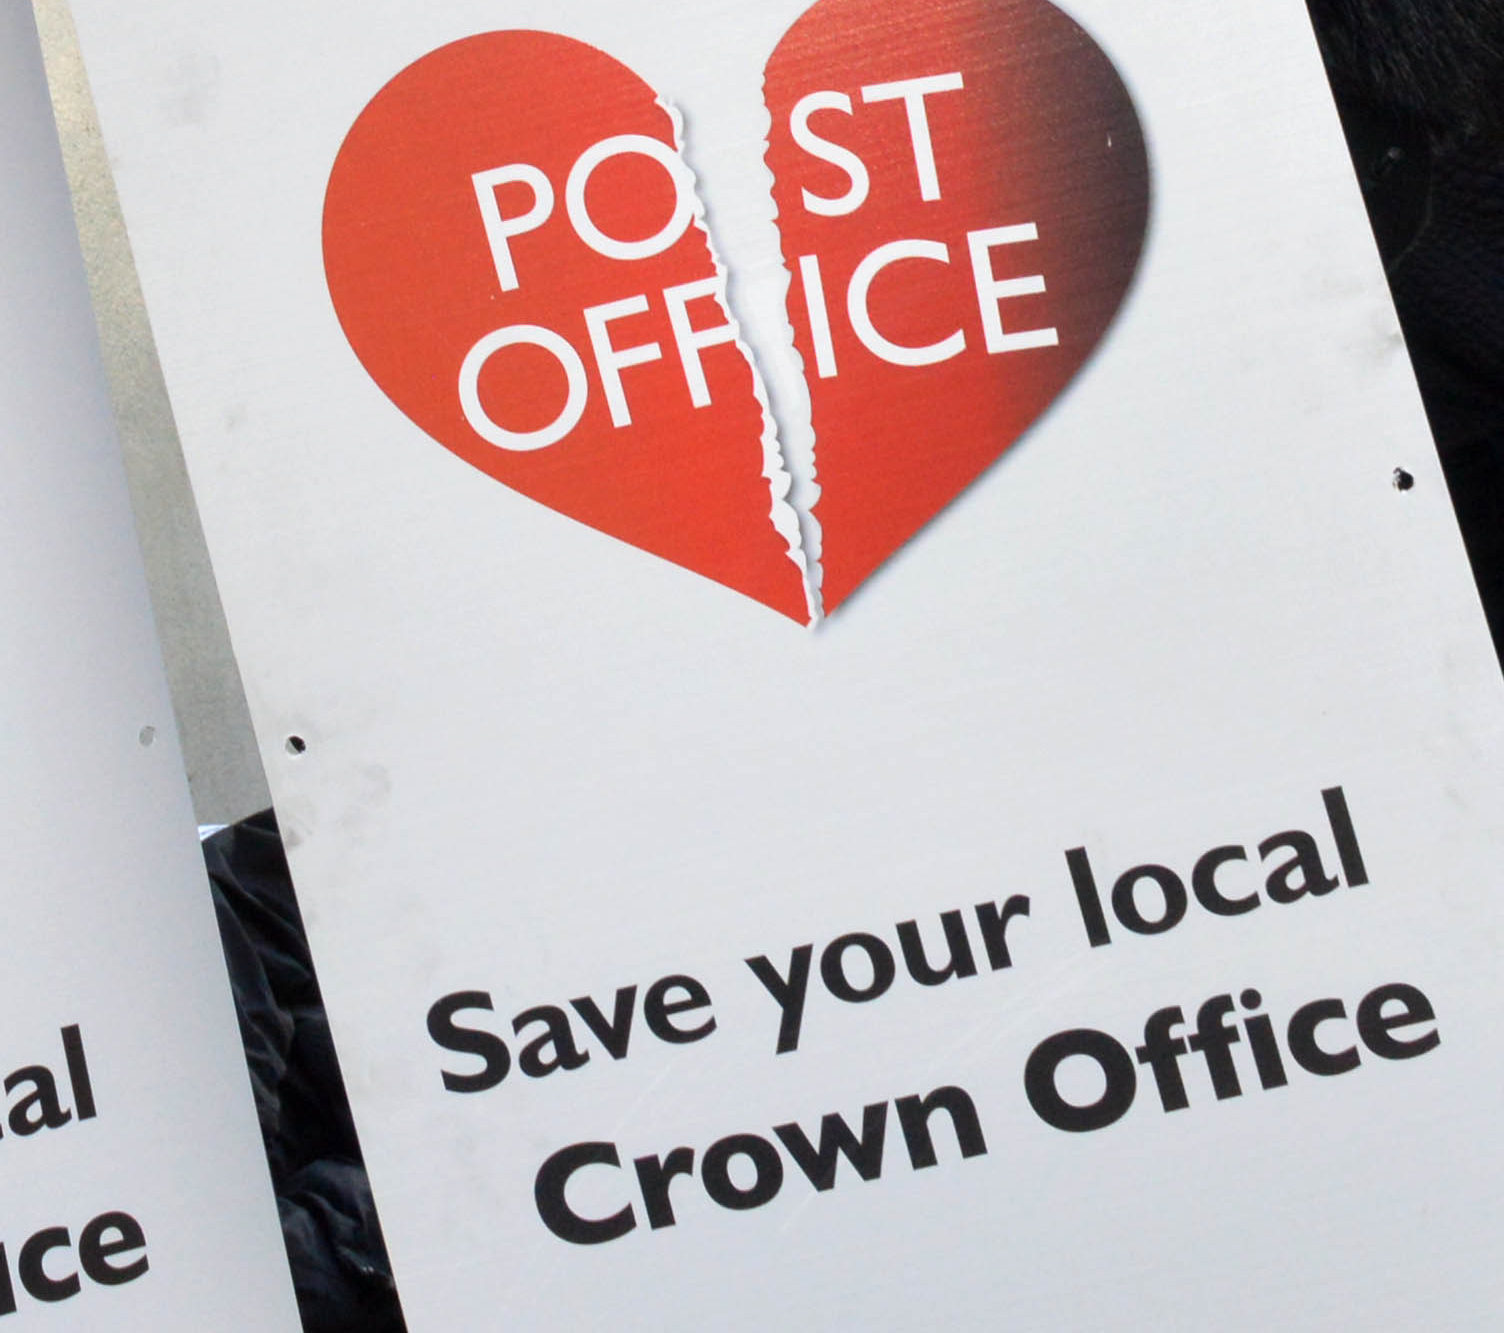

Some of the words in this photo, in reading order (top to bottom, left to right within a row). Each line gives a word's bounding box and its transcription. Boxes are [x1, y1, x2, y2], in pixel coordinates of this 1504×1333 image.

[424, 973, 717, 1094] Save
[745, 892, 1031, 1055] your
[1064, 786, 1371, 949] local
[533, 1084, 989, 1246] Crown
[1023, 979, 1441, 1133] Office
